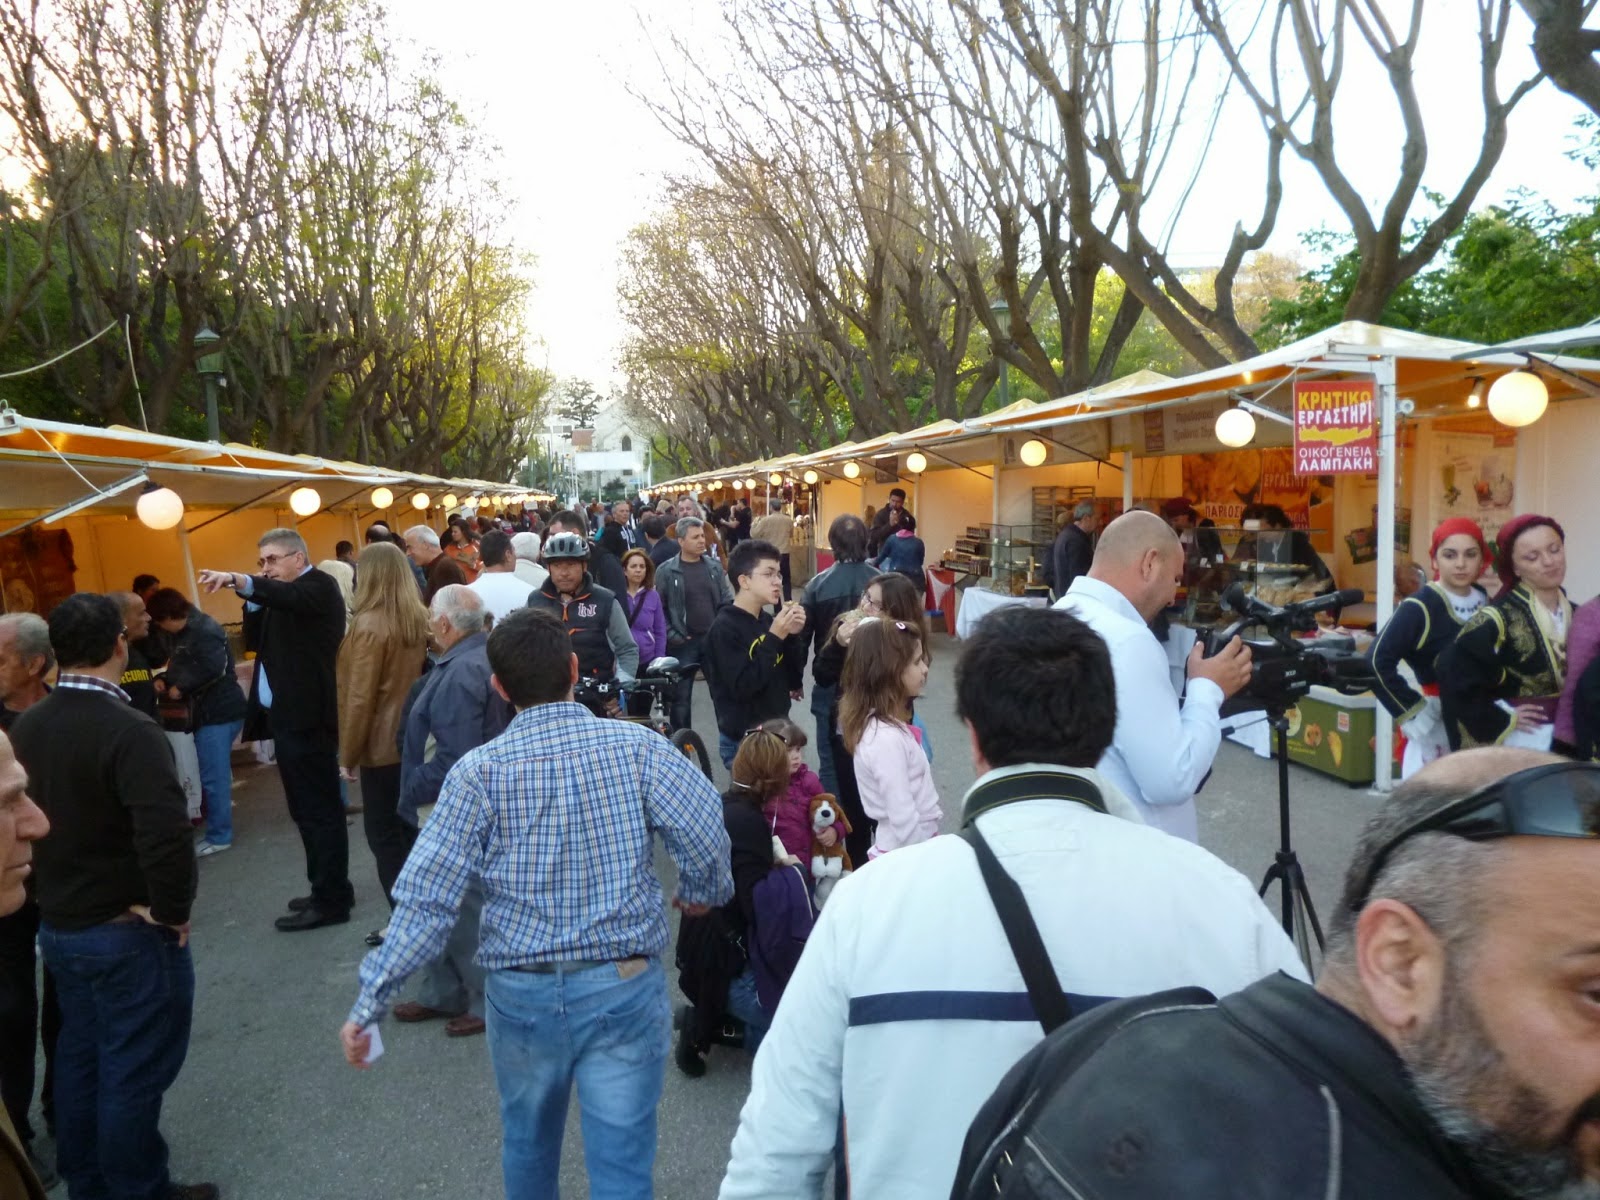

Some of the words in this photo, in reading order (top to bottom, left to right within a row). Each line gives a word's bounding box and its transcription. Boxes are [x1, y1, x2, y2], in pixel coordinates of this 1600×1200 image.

[1299, 391, 1371, 410] ΚΡΗΤΙΚΟ
[1299, 400, 1371, 424] ΕΡΓΑΣΤΗΡΙ
[1299, 446, 1371, 457] ΟΙΚΟΓΕΝΕΙΑ
[1300, 457, 1372, 471] ΛΑΜΠΑΚΗ
